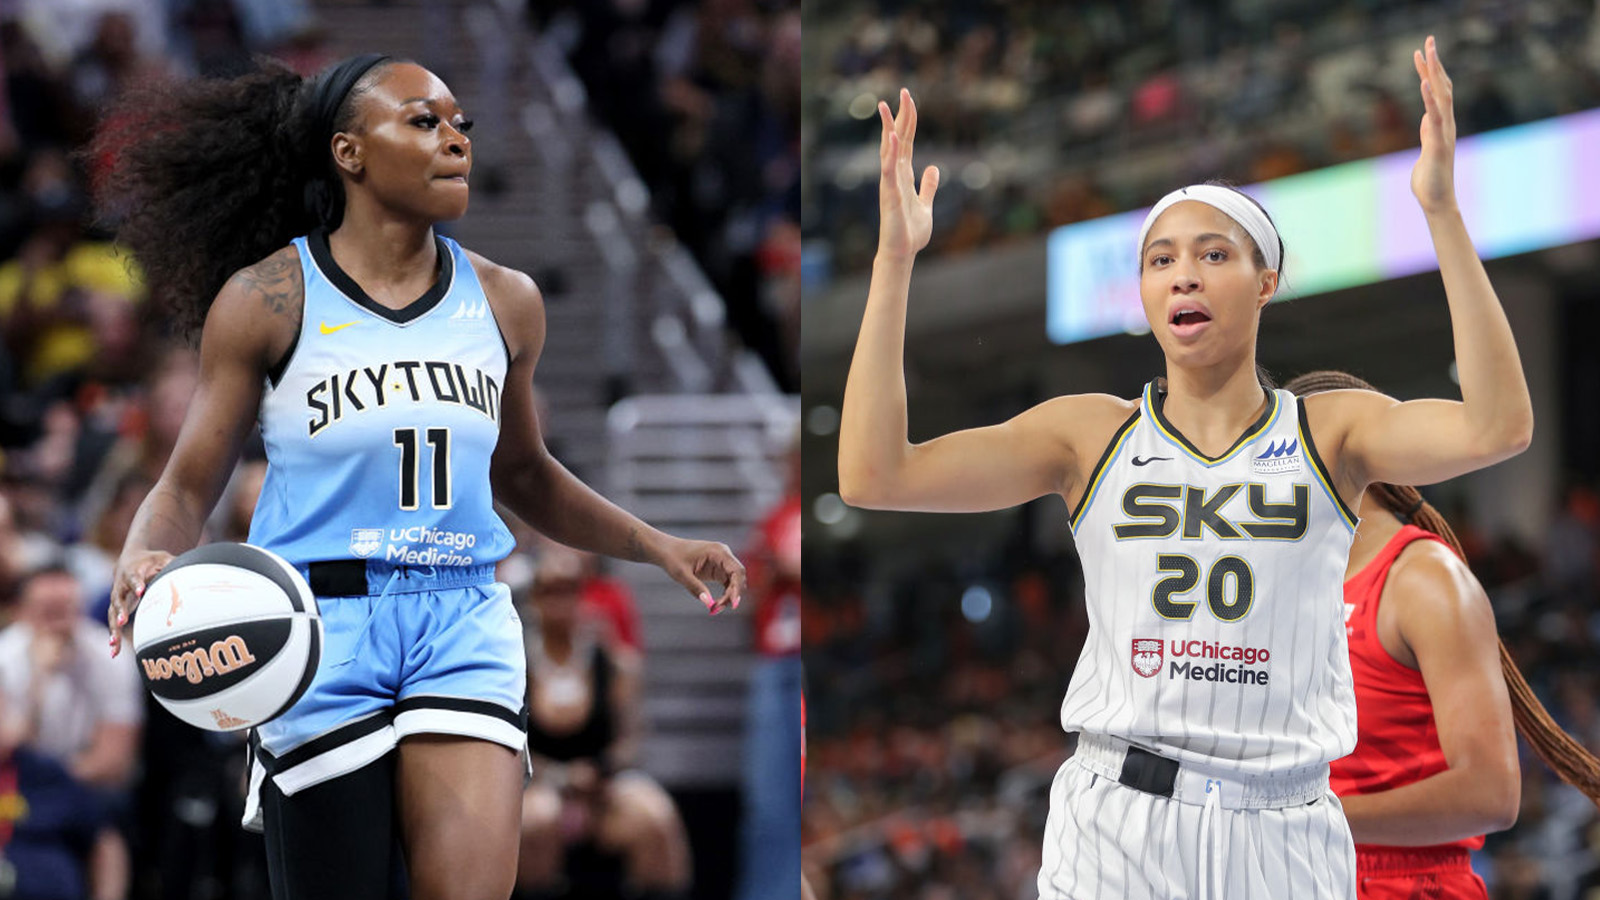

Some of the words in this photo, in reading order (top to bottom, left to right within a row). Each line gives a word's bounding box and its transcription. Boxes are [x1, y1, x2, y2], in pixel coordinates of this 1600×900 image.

[393, 427, 452, 511] 11
[1253, 458, 1299, 467] MAGELLAN
[1112, 482, 1311, 541] SKY
[389, 526, 476, 550] UChicago
[385, 543, 473, 566] Medicine
[1151, 552, 1255, 623] 20
[142, 635, 256, 684] Wilson
[1170, 640, 1270, 665] UChicago
[1169, 661, 1269, 685] Medicine
